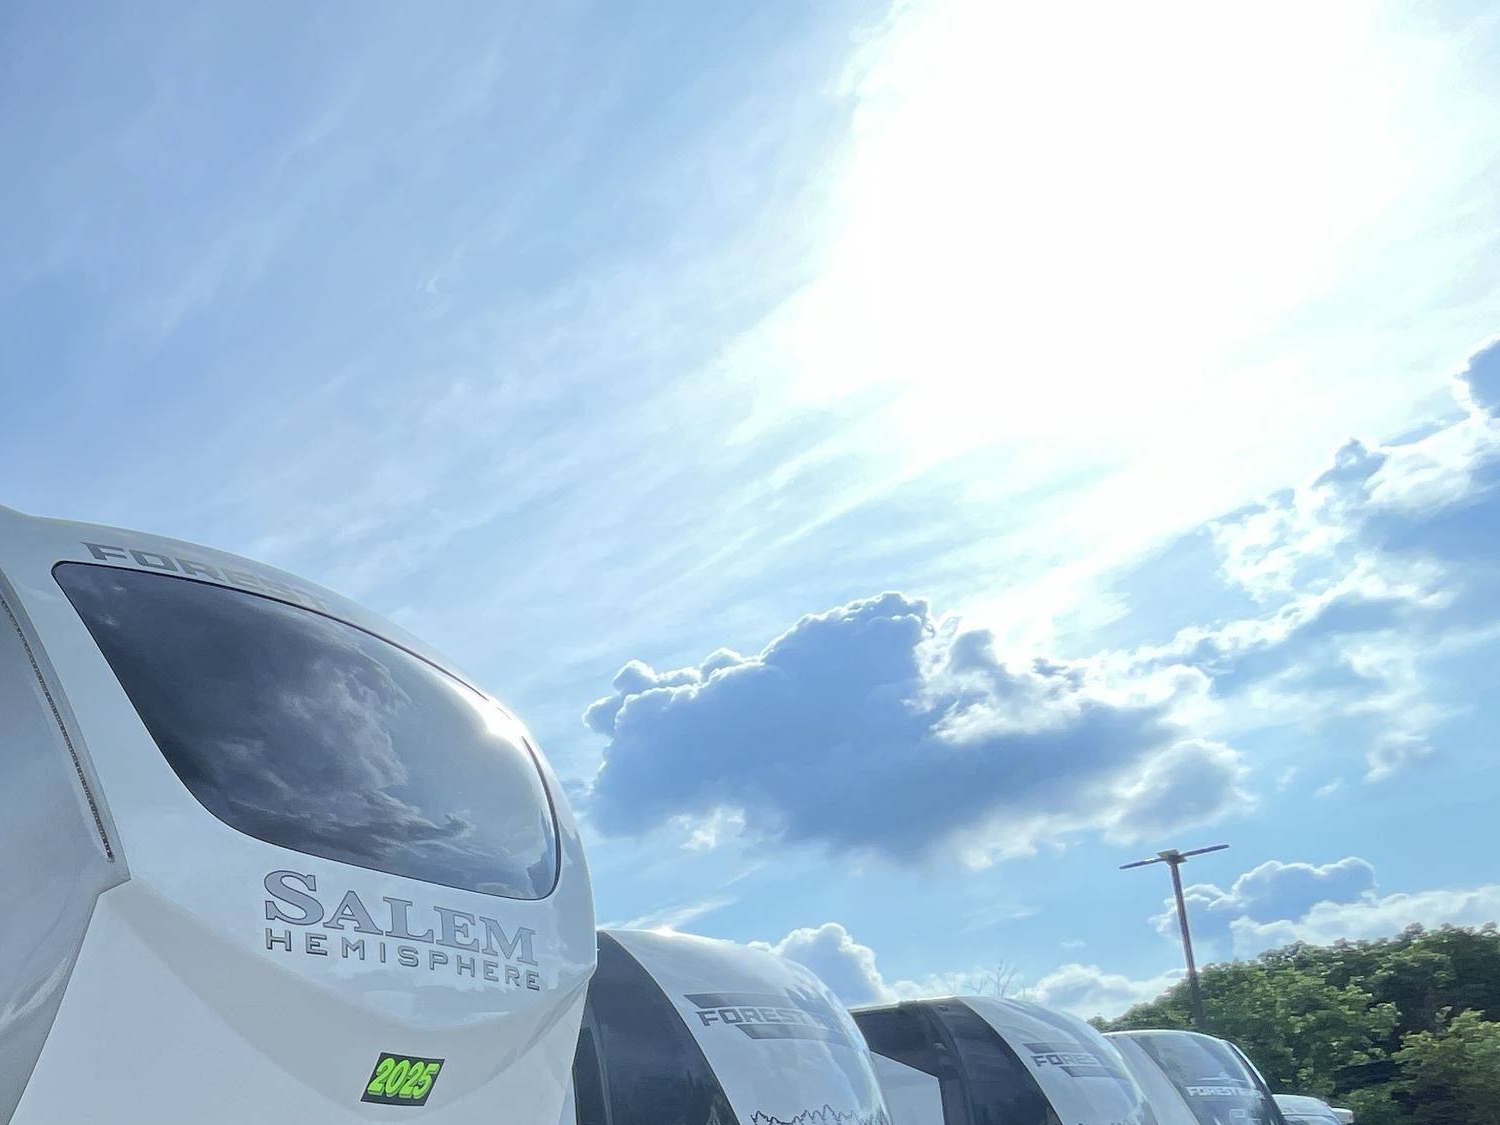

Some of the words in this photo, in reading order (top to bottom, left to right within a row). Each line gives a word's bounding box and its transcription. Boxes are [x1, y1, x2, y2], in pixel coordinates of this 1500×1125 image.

[263, 869, 539, 966] SALEM
[265, 927, 541, 991] HEMISPHERE
[695, 1007, 810, 1027] FOREST
[366, 1057, 441, 1100] 2025
